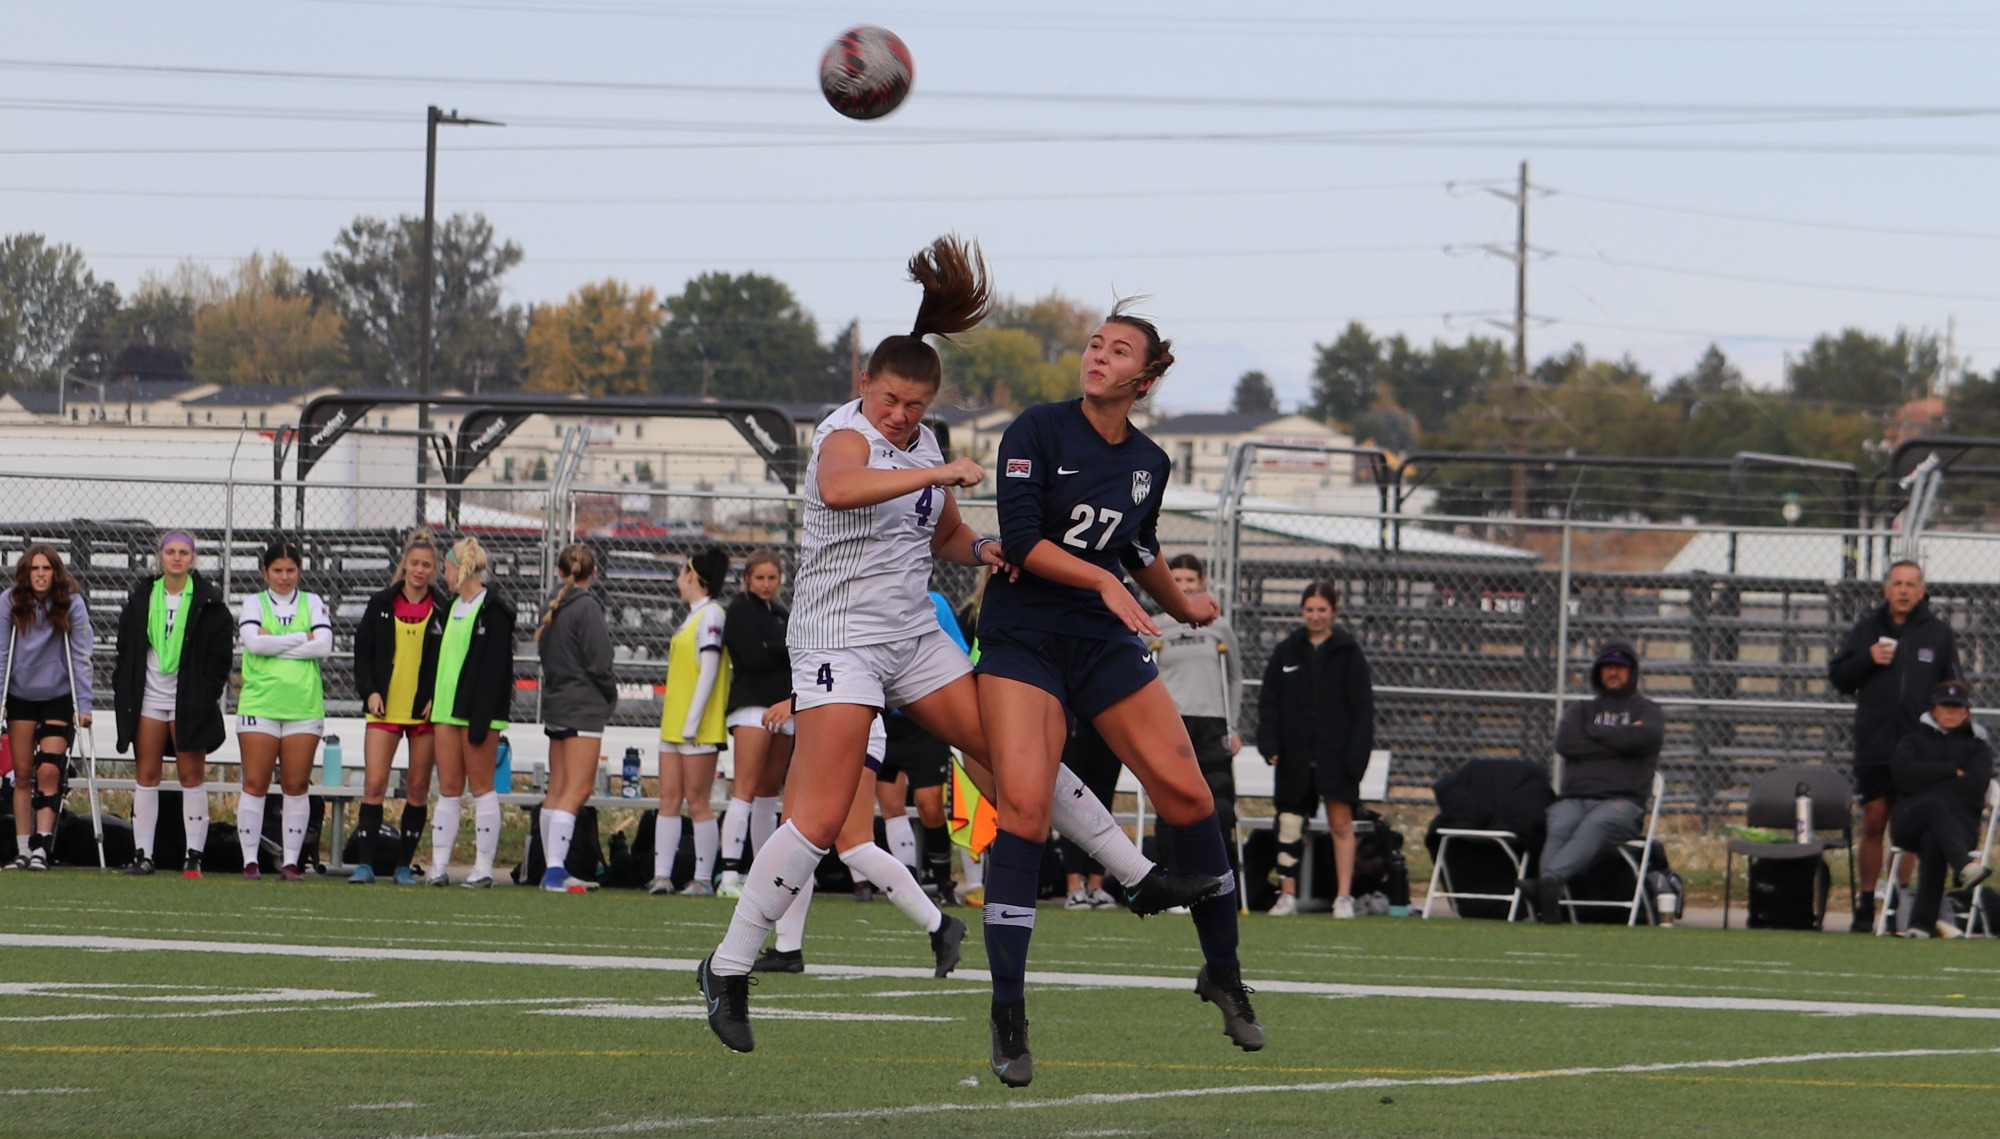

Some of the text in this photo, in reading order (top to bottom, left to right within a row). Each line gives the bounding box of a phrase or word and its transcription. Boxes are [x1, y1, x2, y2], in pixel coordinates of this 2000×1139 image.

[915, 486, 933, 526] 4
[1062, 503, 1123, 551] 27
[816, 663, 834, 692] 4
